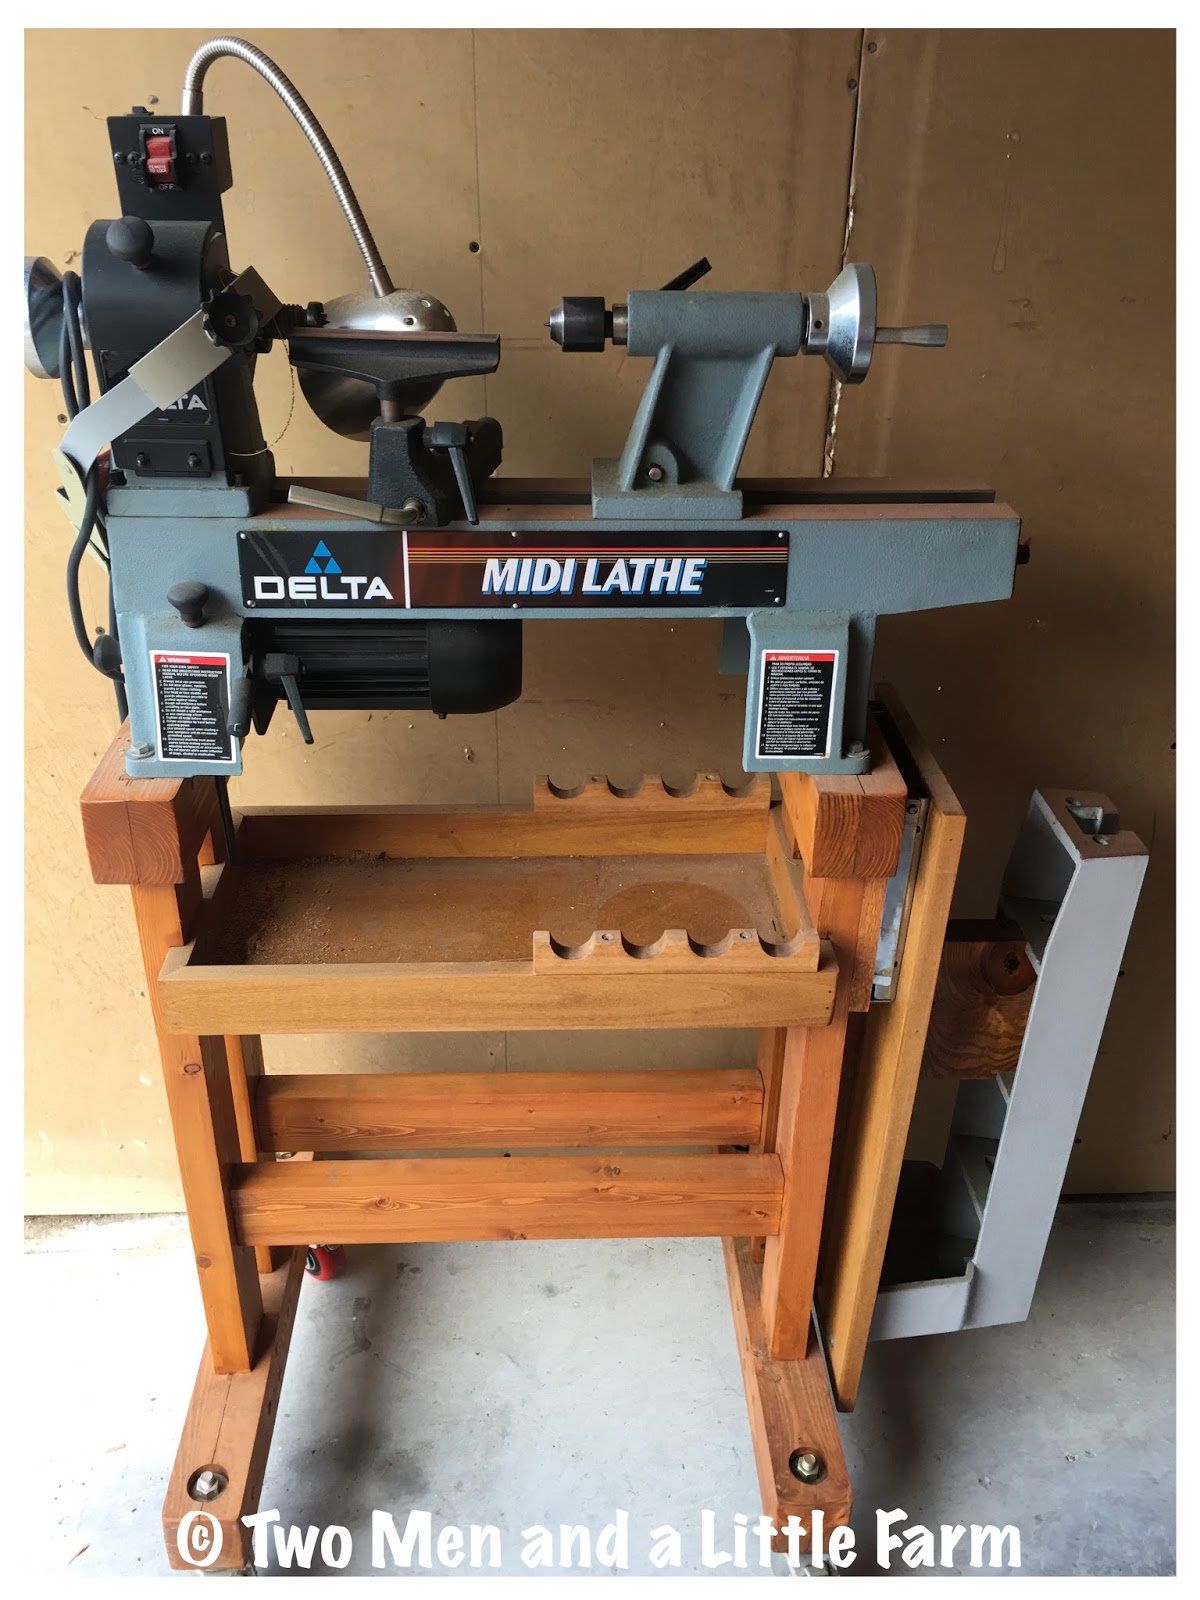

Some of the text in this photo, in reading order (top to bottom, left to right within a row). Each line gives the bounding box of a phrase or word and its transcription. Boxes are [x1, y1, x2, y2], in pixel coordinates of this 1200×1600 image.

[253, 576, 394, 600] DELTA
[481, 558, 708, 595] MIDI LATHE
